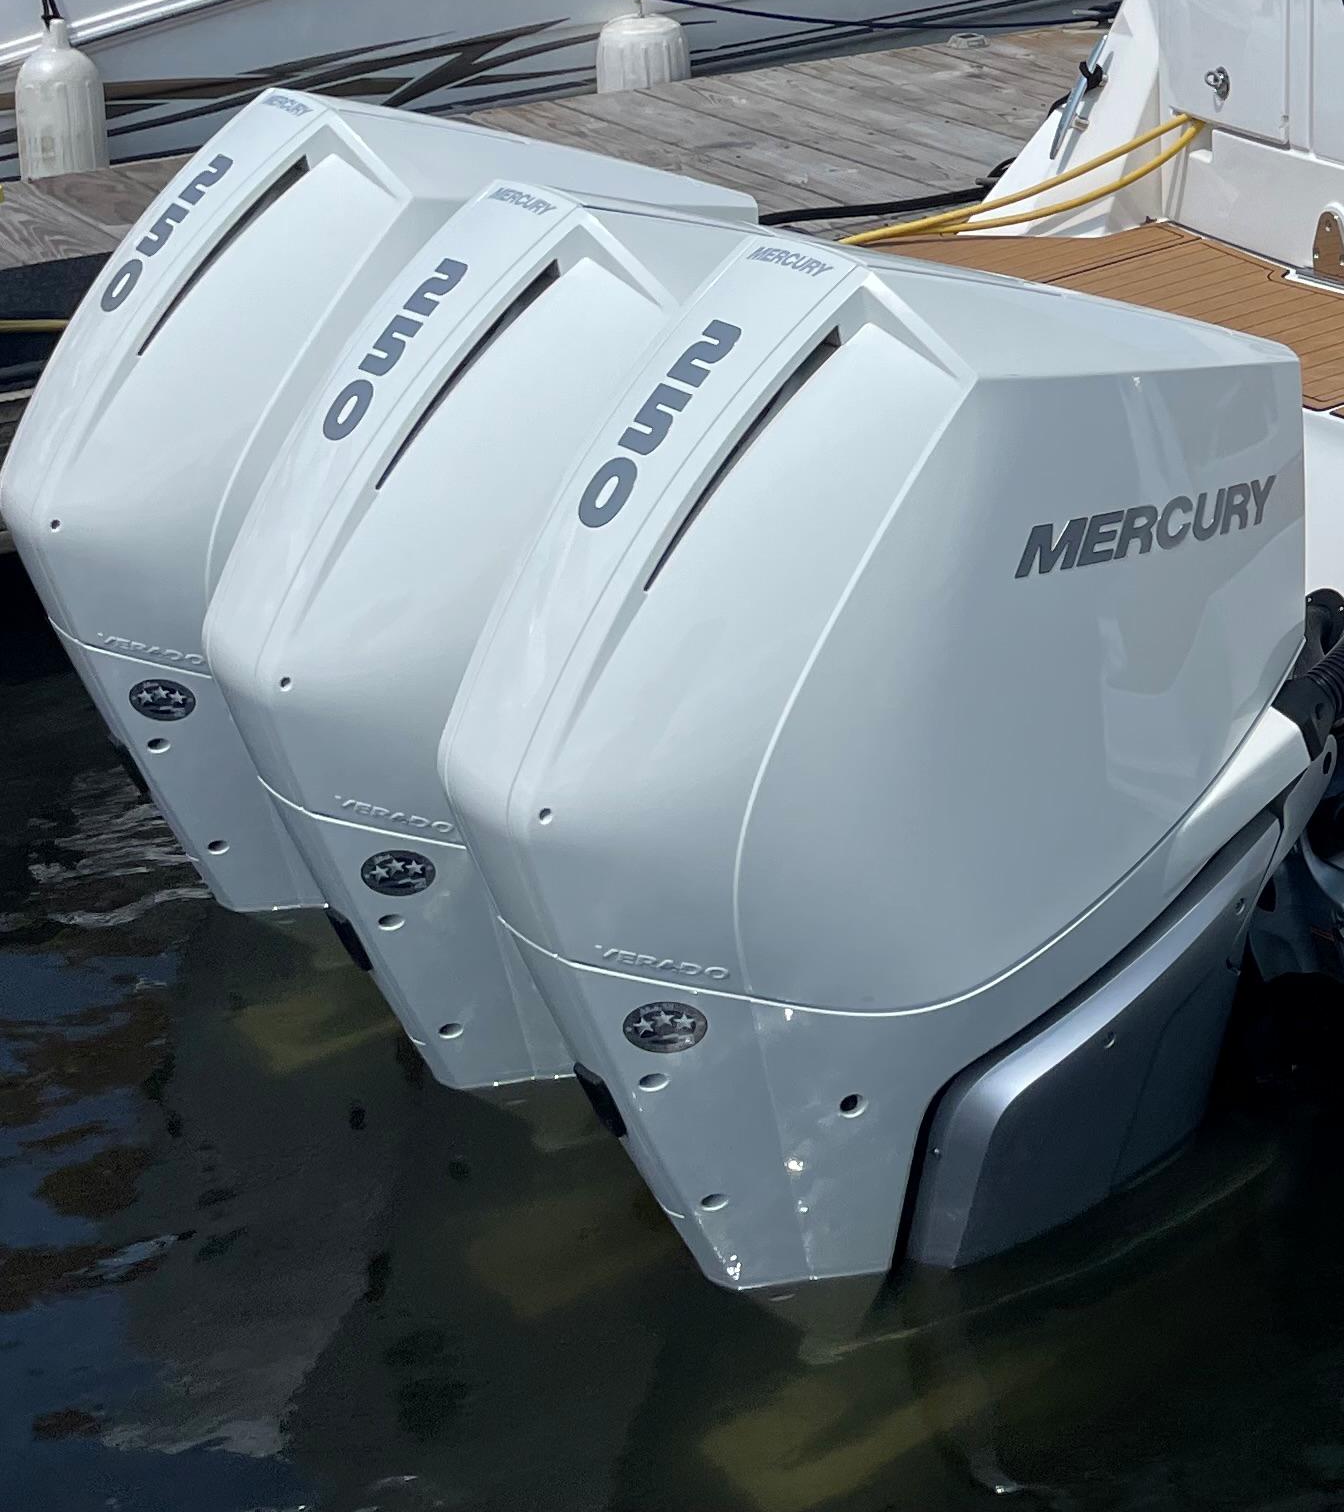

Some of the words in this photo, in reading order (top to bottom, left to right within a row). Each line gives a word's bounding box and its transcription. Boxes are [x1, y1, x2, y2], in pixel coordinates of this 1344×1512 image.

[100, 153, 233, 312] 250
[488, 188, 556, 215] MERCURY
[746, 247, 833, 277] MERCURY
[322, 257, 468, 441] 250
[578, 319, 742, 528] 250
[1014, 475, 1277, 578] MERCURY
